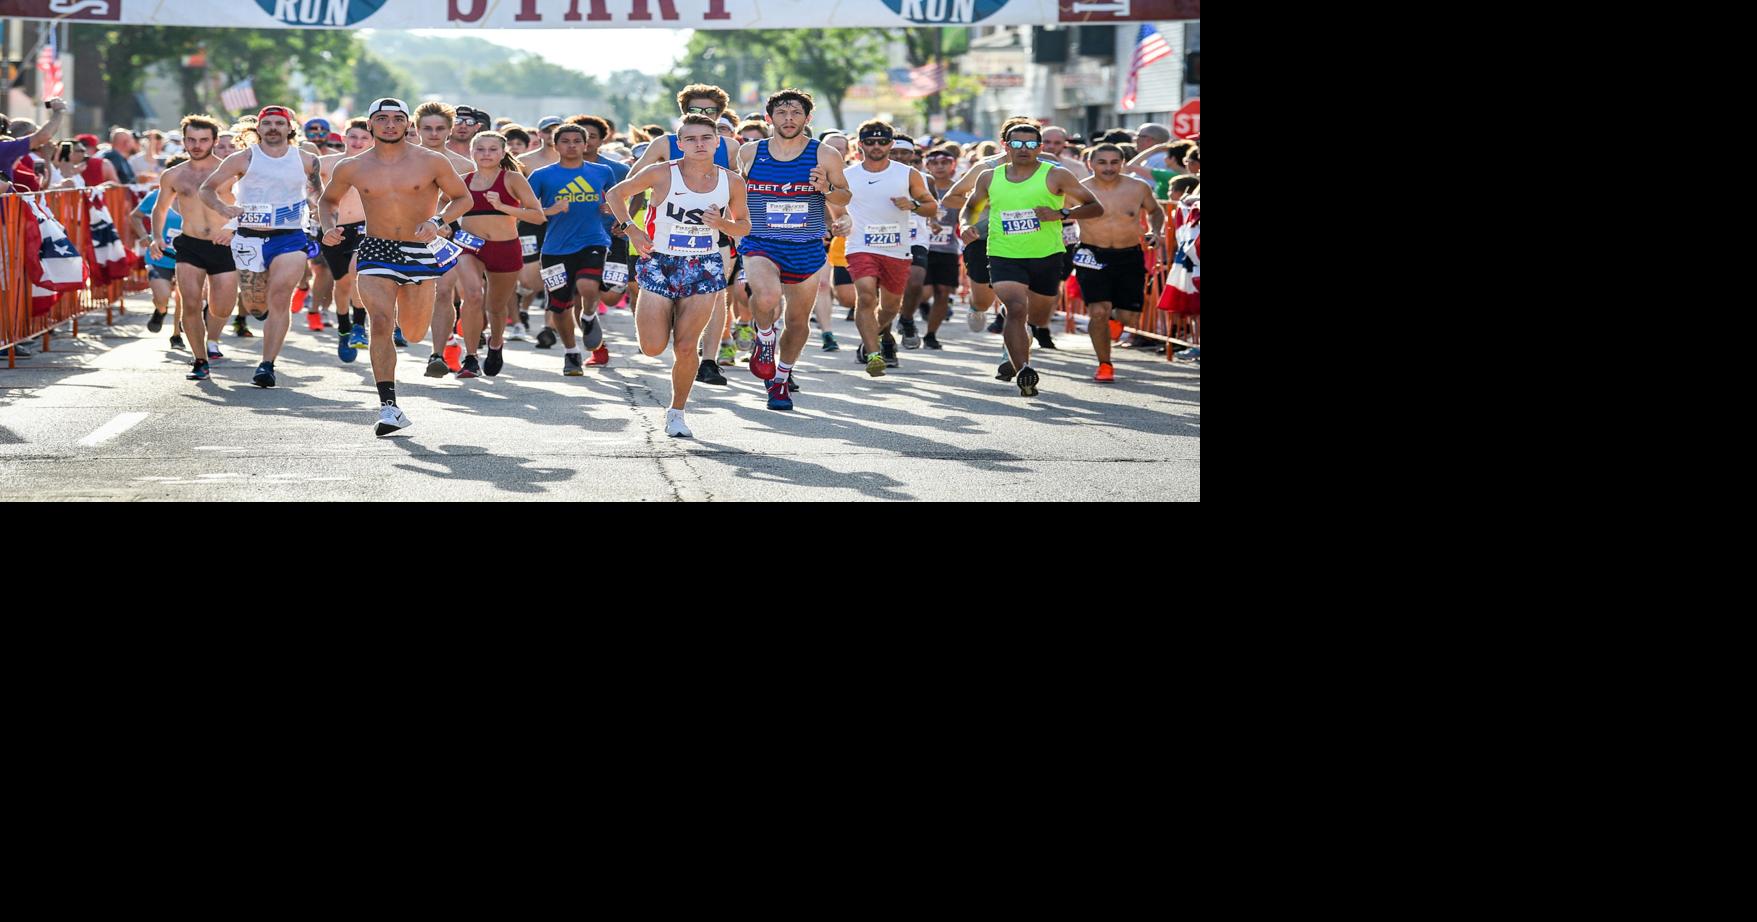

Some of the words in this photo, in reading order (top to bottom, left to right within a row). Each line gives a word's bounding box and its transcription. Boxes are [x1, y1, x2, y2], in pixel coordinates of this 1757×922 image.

[555, 192, 599, 203] adidas
[242, 213, 266, 223] 2657
[666, 202, 726, 225] US
[783, 213, 792, 224] 7
[1007, 219, 1034, 231] 1920
[459, 232, 473, 245] 15
[687, 237, 697, 248] 4
[869, 233, 896, 244] 2270
[1080, 255, 1103, 267] 185
[545, 273, 566, 288] 1585
